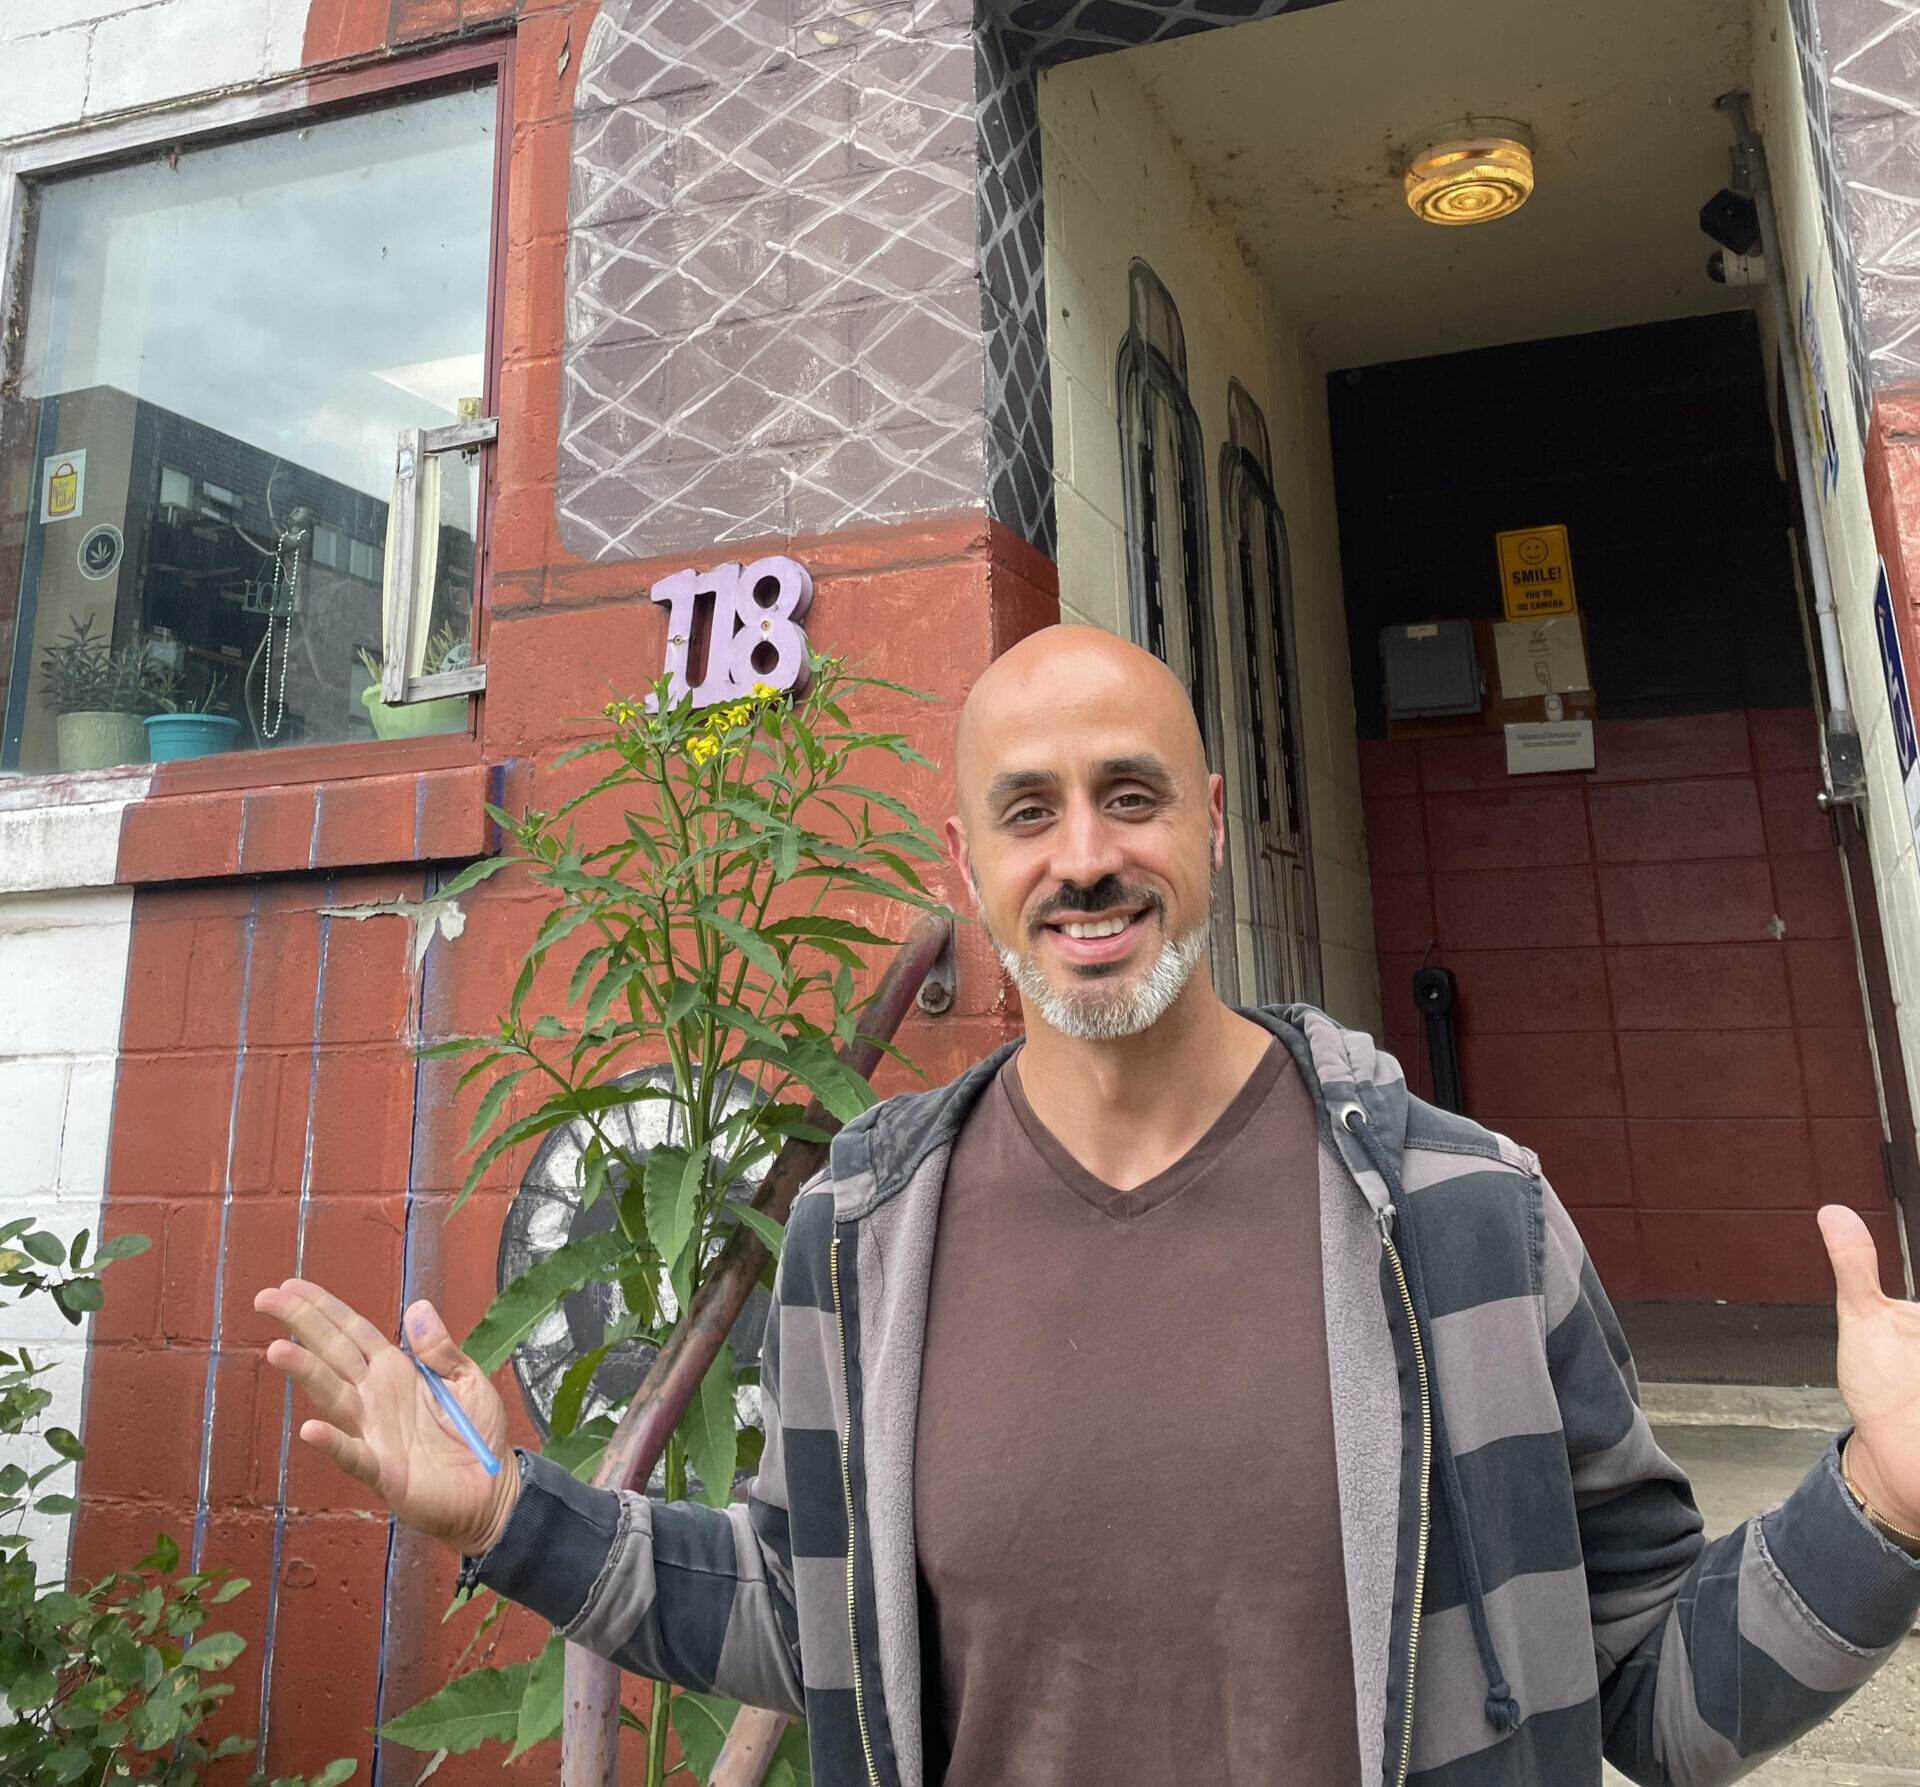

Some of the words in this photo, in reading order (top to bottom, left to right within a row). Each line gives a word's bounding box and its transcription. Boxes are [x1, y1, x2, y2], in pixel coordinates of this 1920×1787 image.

[1511, 566, 1562, 584] SMILE!
[1524, 589, 1553, 600] YOU'RE
[1517, 603, 1529, 611] ON
[1530, 599, 1564, 610] CAMERA
[644, 555, 812, 713] 118
